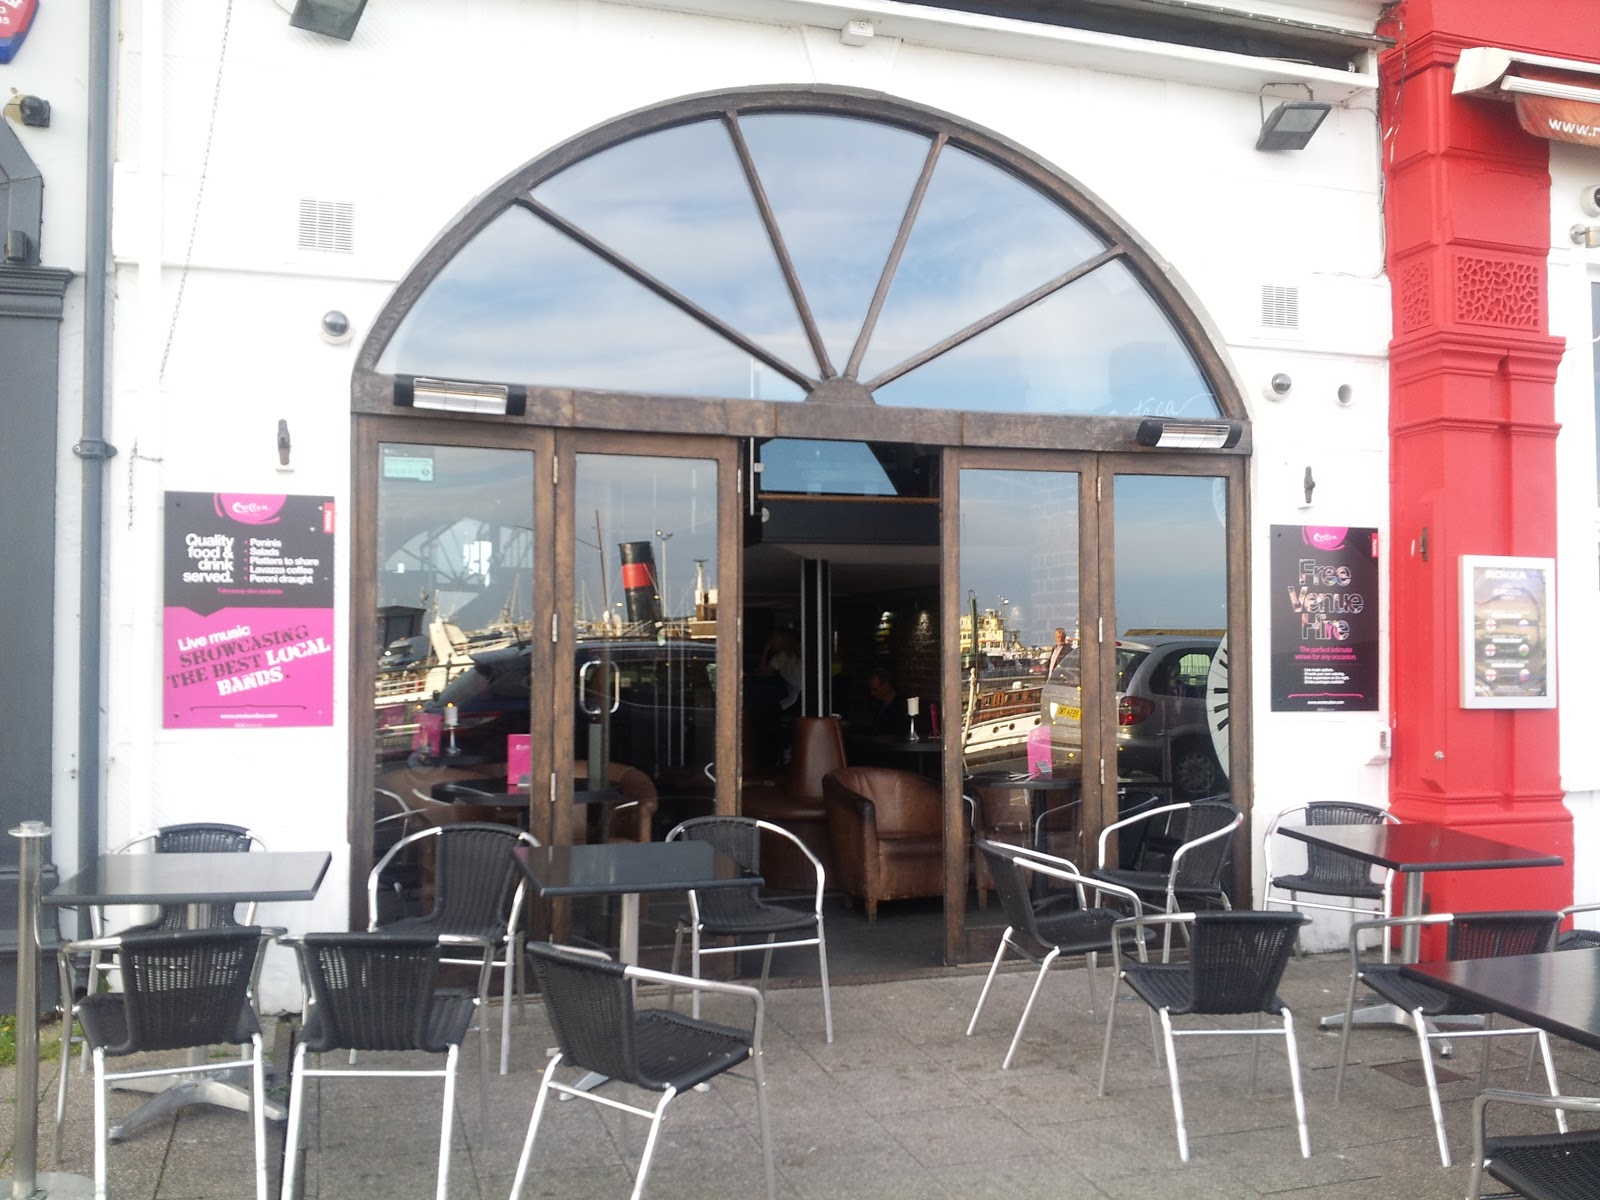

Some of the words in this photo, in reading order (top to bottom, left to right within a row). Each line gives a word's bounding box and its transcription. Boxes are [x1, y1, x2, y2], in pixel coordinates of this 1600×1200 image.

[185, 533, 235, 549] Quality
[249, 538, 282, 548] Paninis
[187, 545, 221, 559] food
[222, 546, 234, 560] &
[249, 547, 280, 556] Salads
[197, 558, 235, 571] drink
[249, 556, 283, 566] Platters
[284, 557, 294, 566] to
[294, 557, 320, 566] share
[182, 569, 235, 583] served.
[249, 565, 285, 574] Lavazza
[286, 566, 314, 575] coffee
[1299, 558, 1352, 586] Free
[249, 574, 278, 583] Peroni
[279, 574, 314, 586] draught
[1287, 586, 1364, 614] Venue
[1301, 613, 1350, 640] Hire
[177, 636, 208, 652] Live
[209, 624, 252, 645] music
[179, 624, 310, 669] SHOWCASING
[167, 667, 209, 689] THE
[212, 653, 261, 679] BEST
[264, 637, 332, 666] LOCAL
[216, 666, 285, 696] BANDS
